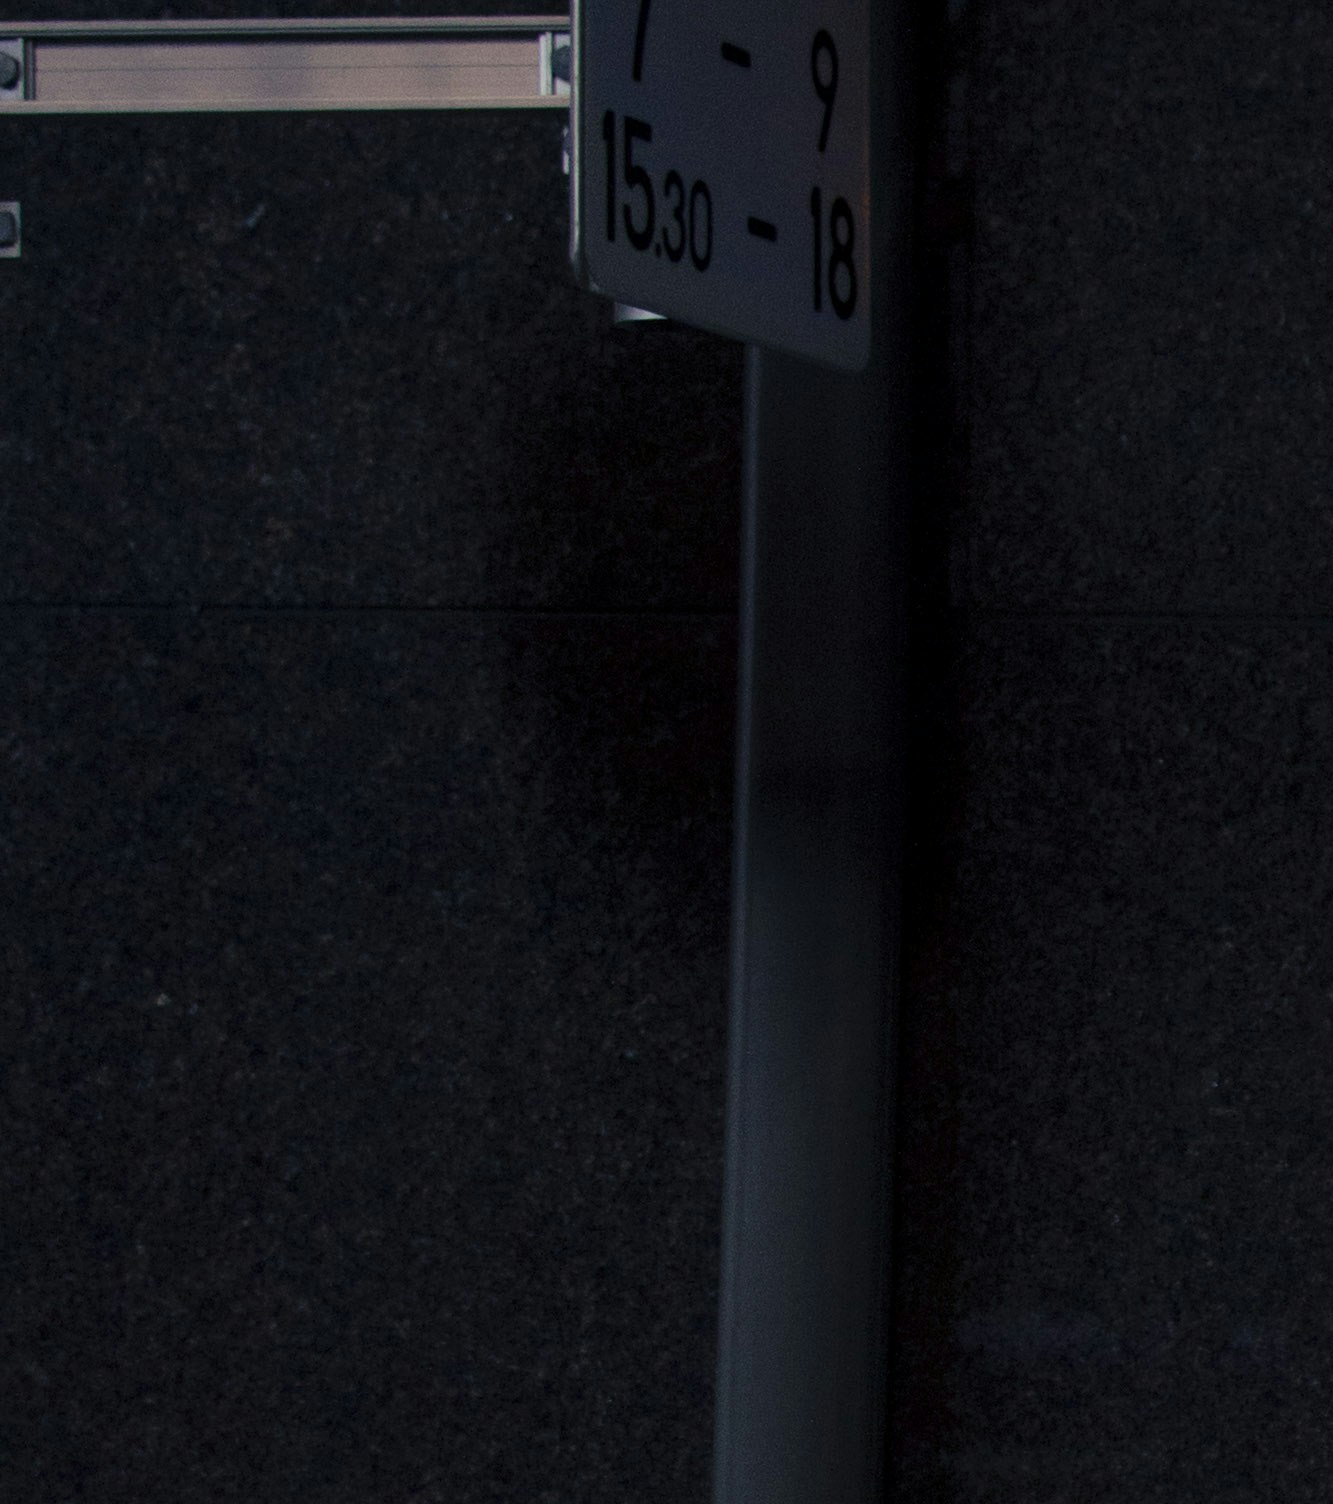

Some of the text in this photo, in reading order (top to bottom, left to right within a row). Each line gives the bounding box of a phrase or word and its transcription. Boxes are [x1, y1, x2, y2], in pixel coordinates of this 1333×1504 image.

[811, 30, 839, 152] 9
[602, 109, 713, 272] 15.30
[810, 188, 857, 320] 18
